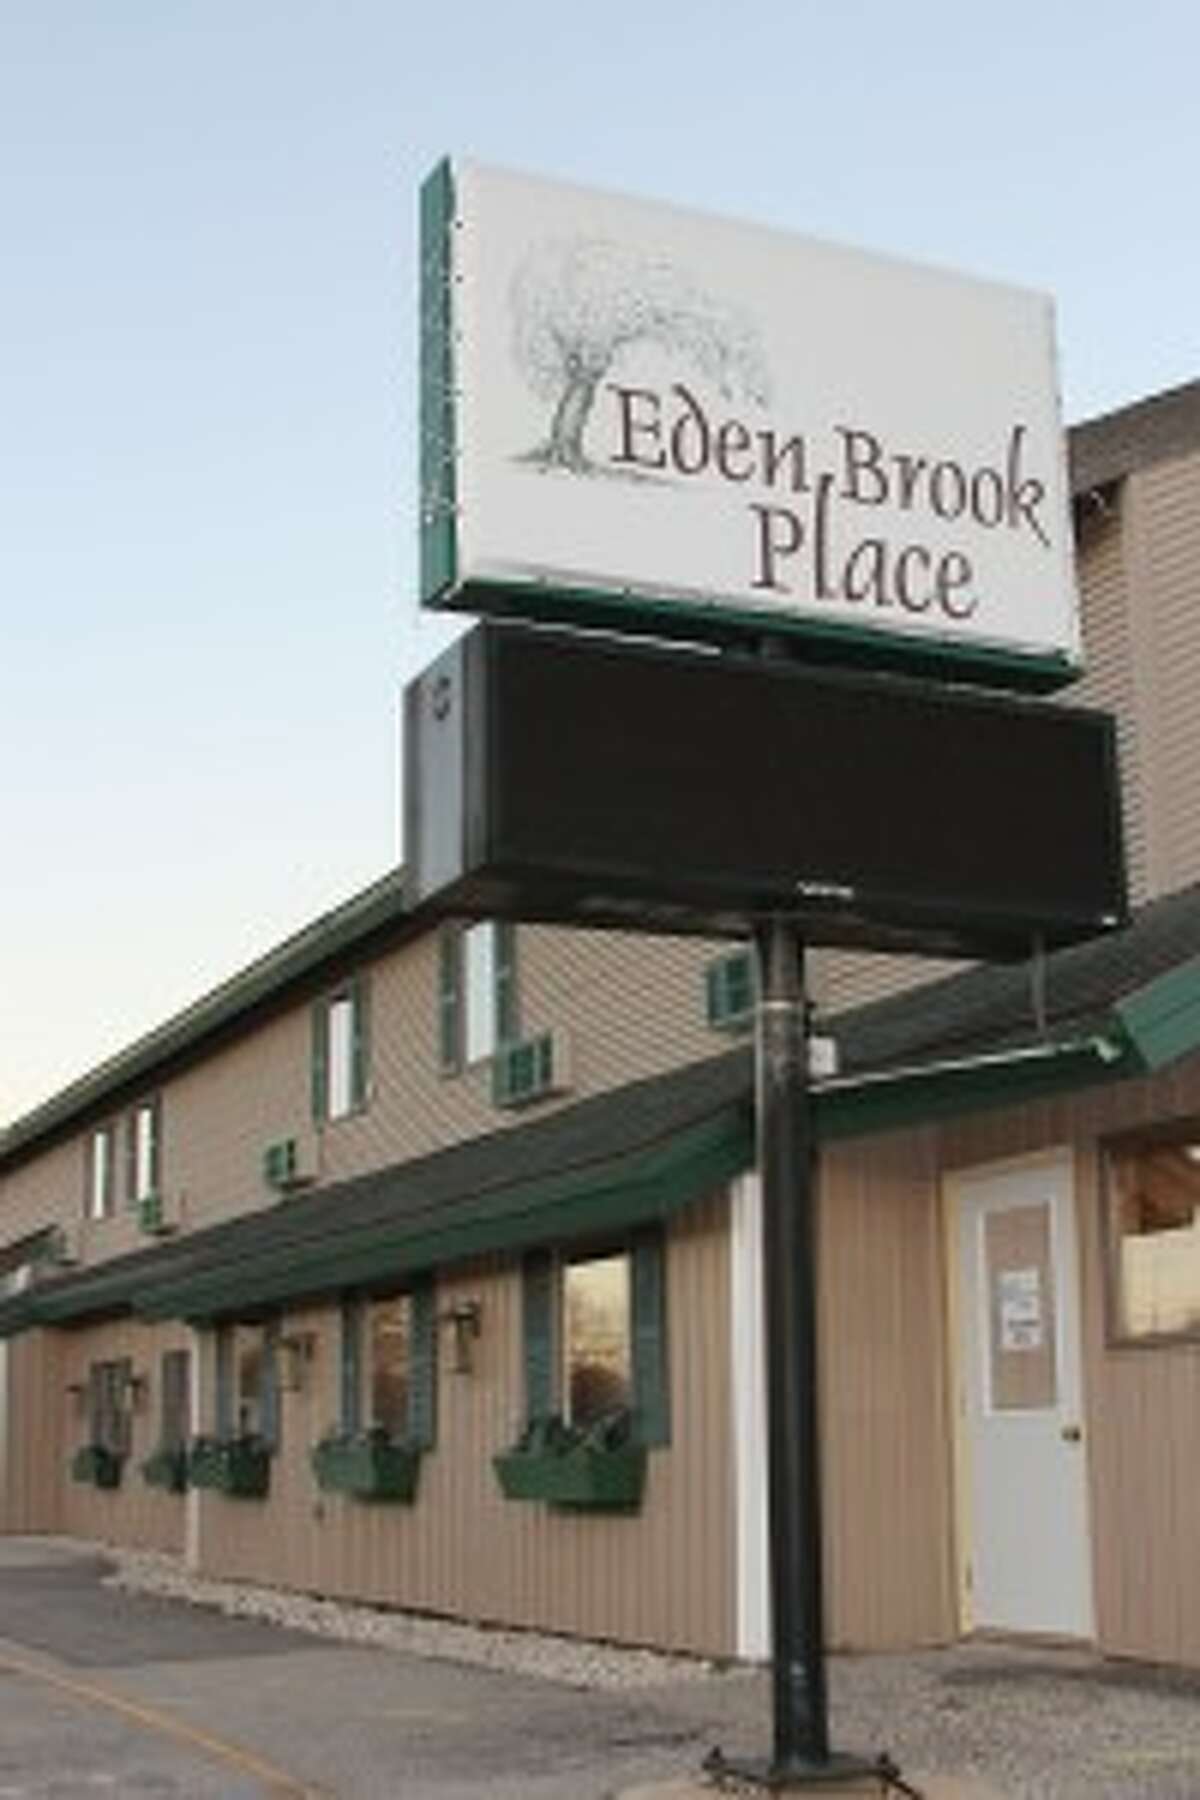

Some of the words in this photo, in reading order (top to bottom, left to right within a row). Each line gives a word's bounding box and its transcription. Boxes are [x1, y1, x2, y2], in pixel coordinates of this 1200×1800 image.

[606, 383, 810, 493] Eden
[834, 425, 1051, 547] Brook
[748, 472, 979, 620] Place
